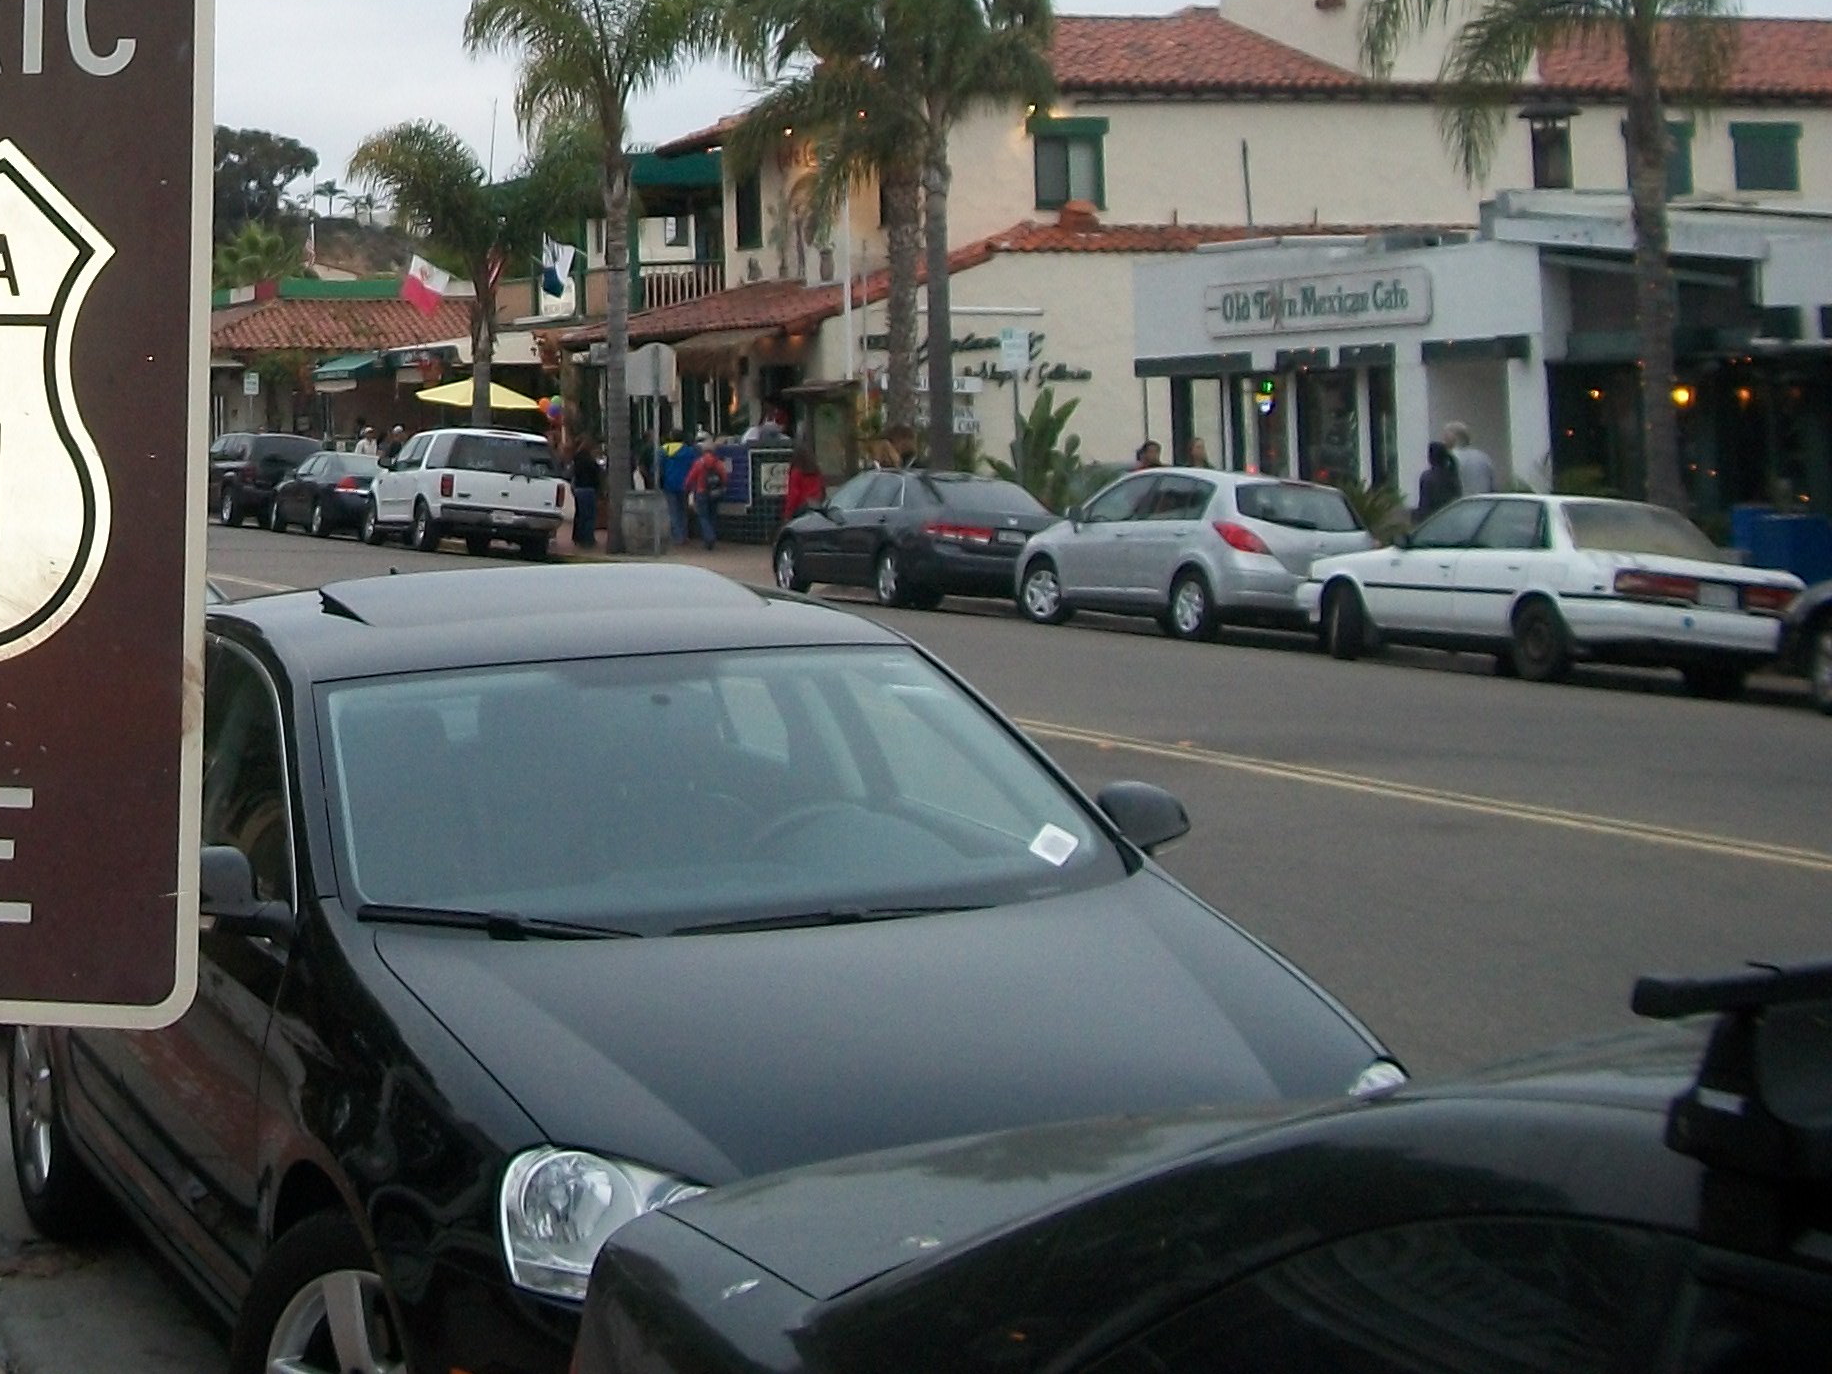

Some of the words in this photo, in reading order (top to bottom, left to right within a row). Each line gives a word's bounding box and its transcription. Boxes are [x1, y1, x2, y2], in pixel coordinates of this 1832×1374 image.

[1221, 289, 1250, 324] Old
[1253, 284, 1298, 321] Ton
[1300, 284, 1369, 318] Mexican
